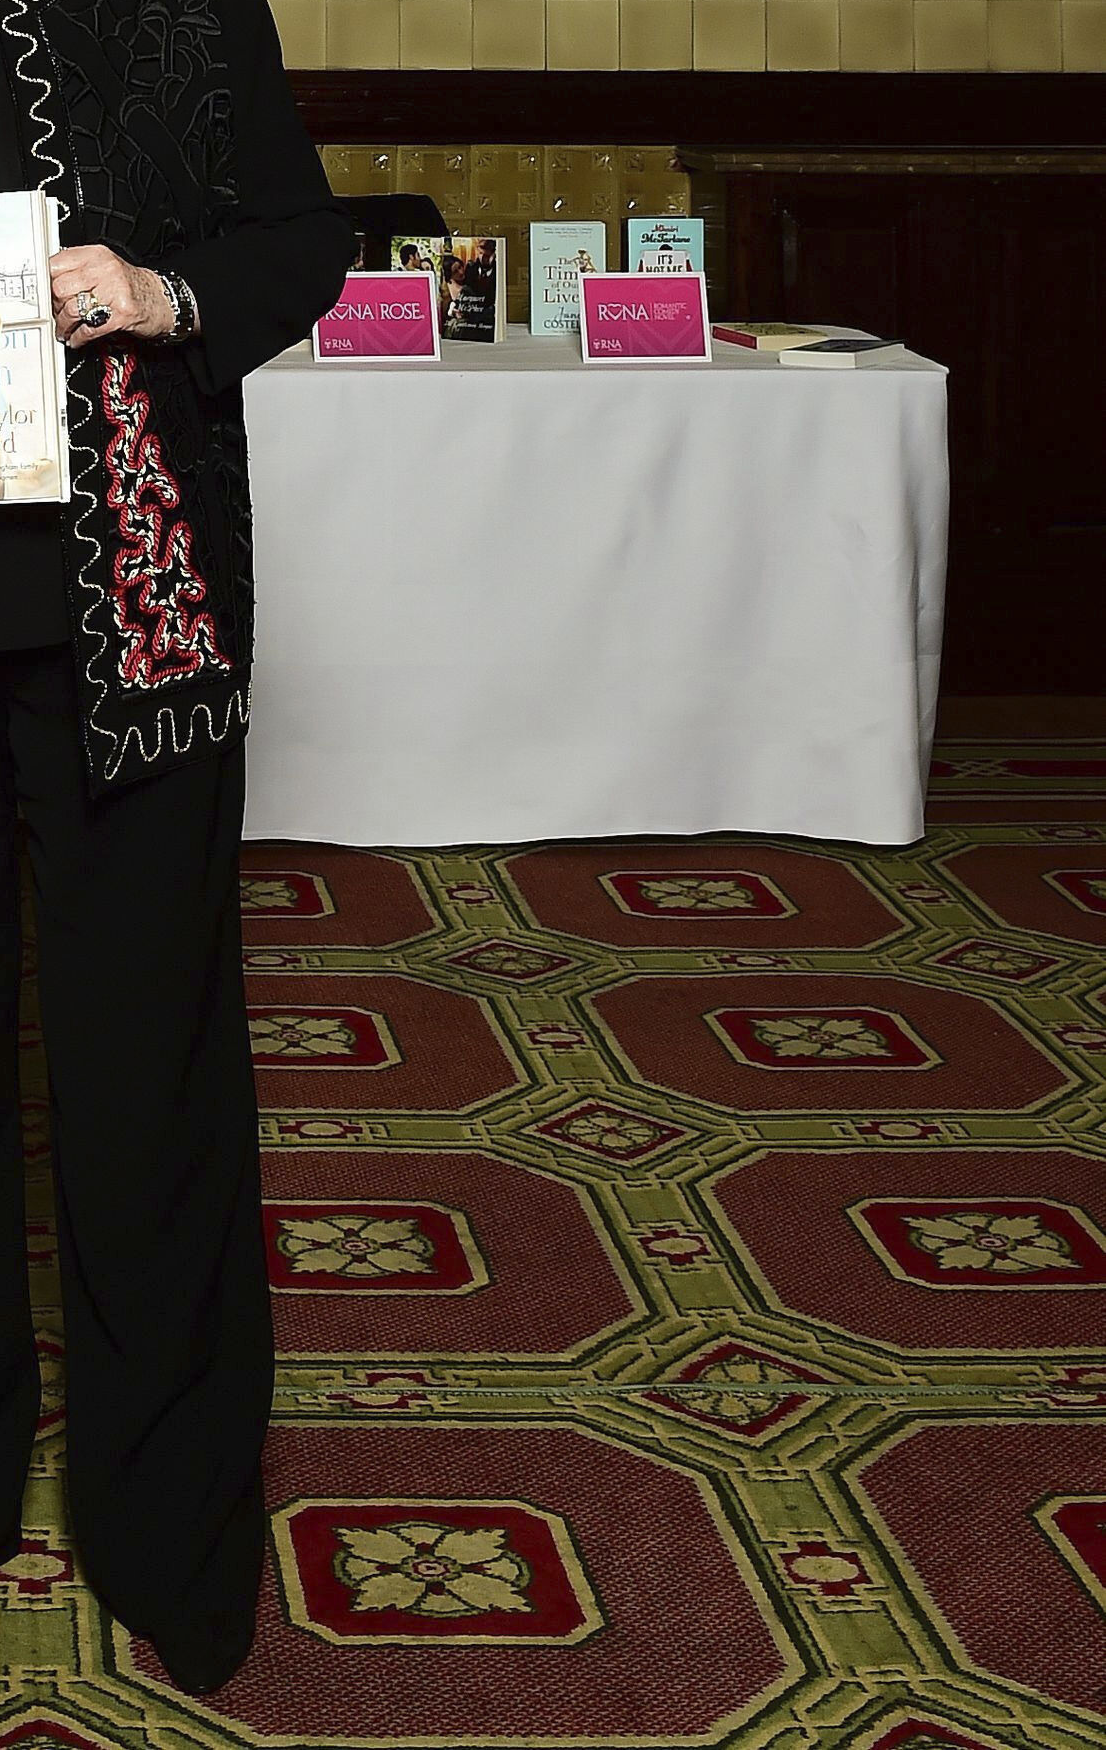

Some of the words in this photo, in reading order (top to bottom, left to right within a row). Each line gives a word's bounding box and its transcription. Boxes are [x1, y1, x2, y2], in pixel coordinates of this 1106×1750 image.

[640, 232, 691, 244] McFarlane
[657, 254, 673, 265] IT'S
[543, 265, 578, 280] Tim
[544, 288, 579, 303] Live
[380, 303, 421, 320] ROSE
[332, 338, 353, 348] RNA
[601, 339, 622, 349] RNA
